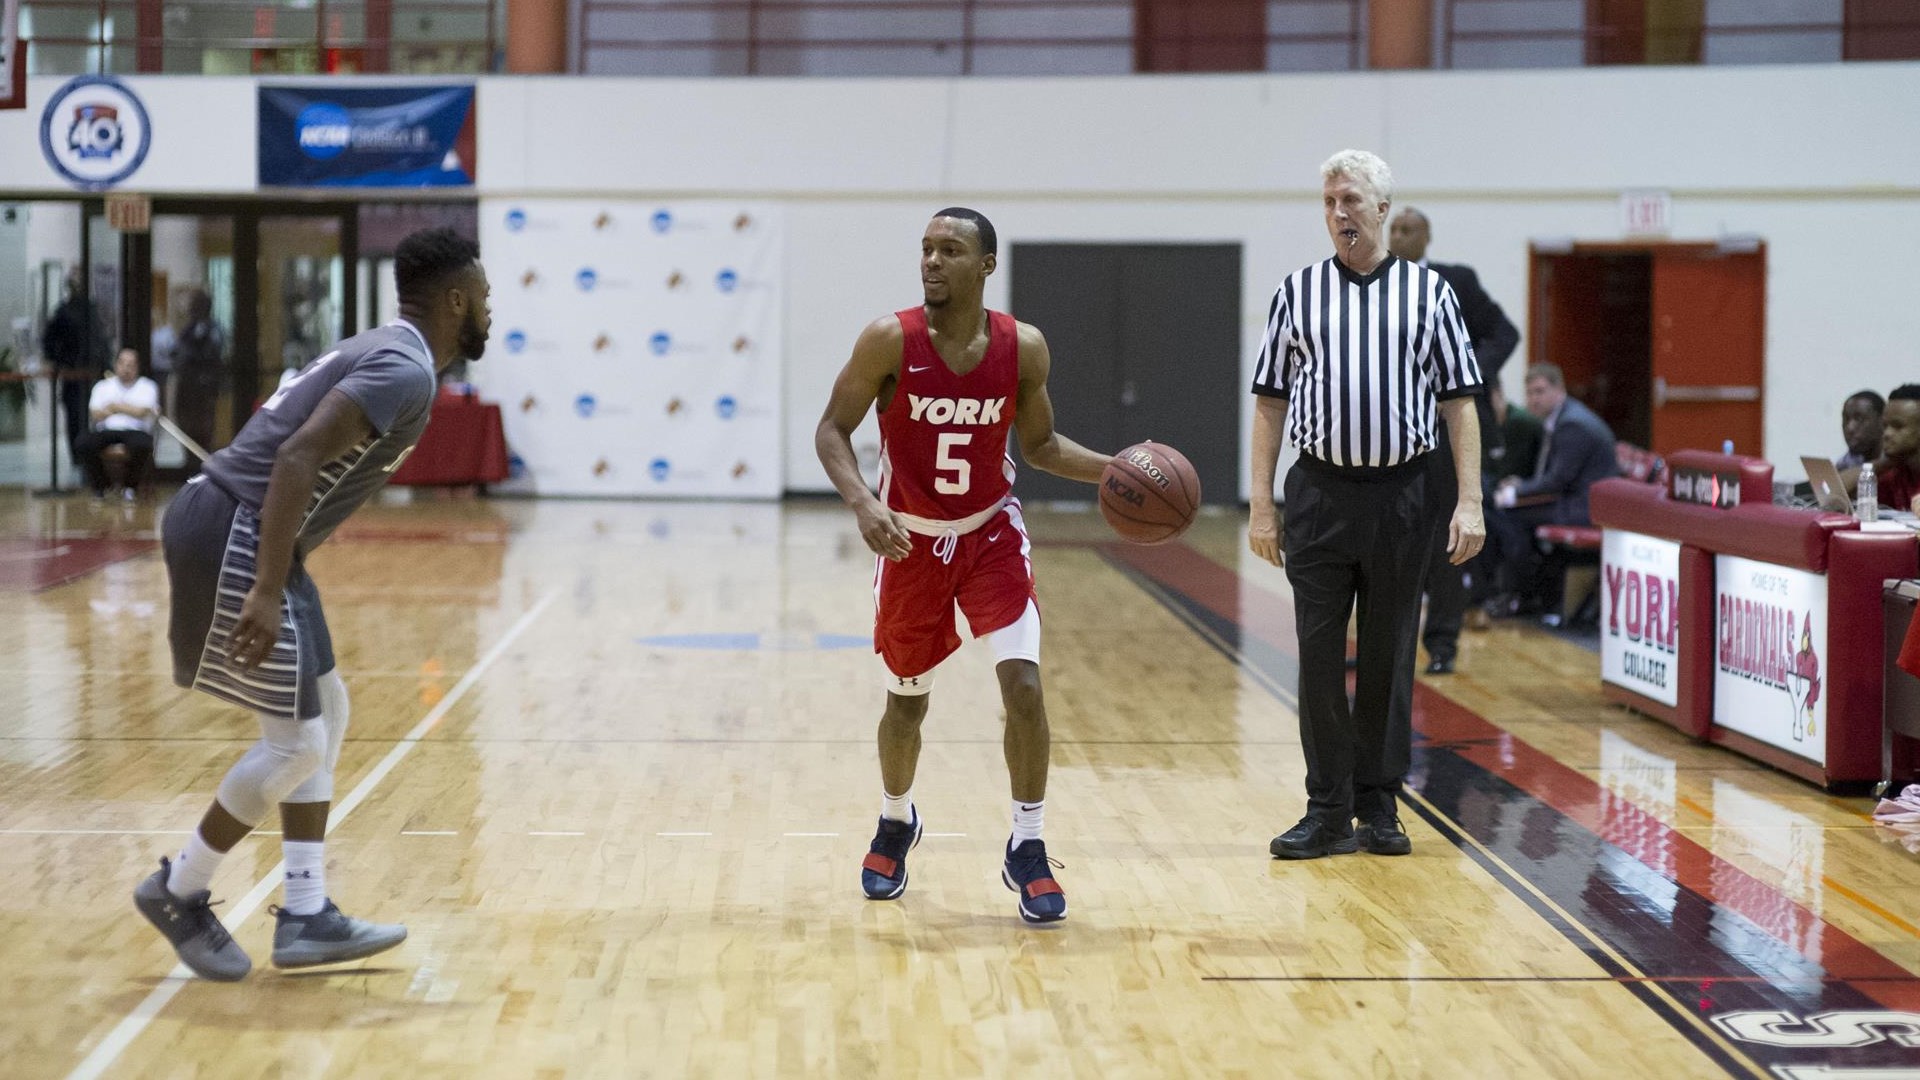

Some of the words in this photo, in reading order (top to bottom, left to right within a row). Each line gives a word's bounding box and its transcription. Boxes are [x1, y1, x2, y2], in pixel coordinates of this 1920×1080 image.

[70, 117, 119, 151] 40
[907, 393, 1007, 426] YORK
[934, 432, 973, 496] 5
[1105, 474, 1147, 508] NCAA
[1719, 591, 1796, 692] CARDINALS
[1623, 650, 1668, 689] COLLEGE
